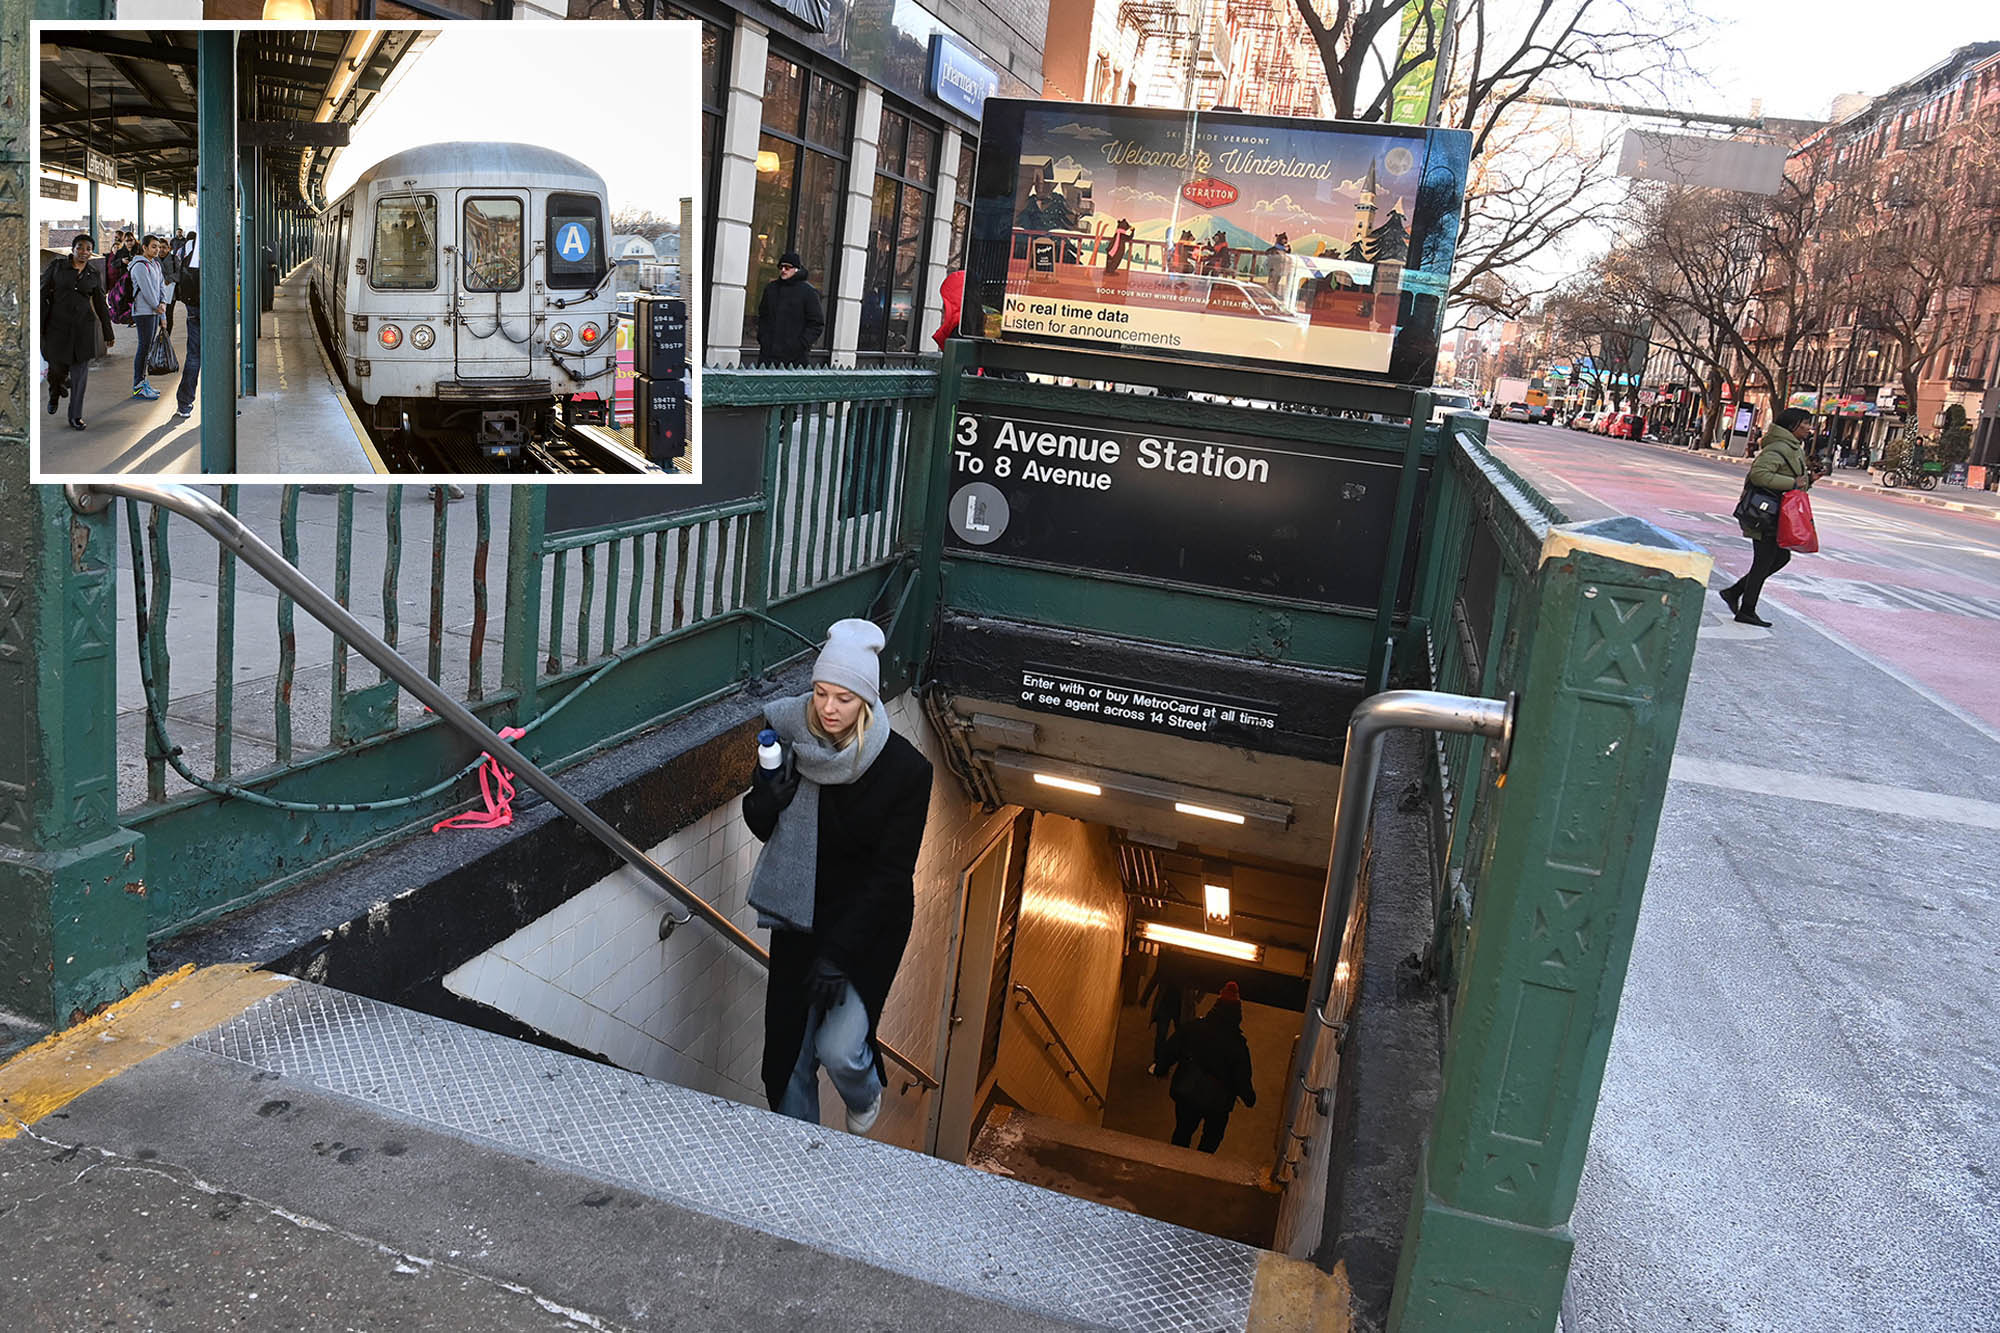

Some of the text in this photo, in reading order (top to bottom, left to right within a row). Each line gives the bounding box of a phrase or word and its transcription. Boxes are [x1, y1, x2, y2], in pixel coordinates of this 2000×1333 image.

[941, 56, 978, 104] pharmacy
[1197, 132, 1218, 141] RIDE
[1223, 135, 1270, 145] VERMONT
[1101, 139, 1332, 180] Welcome to Winterland
[1185, 186, 1234, 200] STRATTON
[562, 225, 585, 255] A
[1006, 298, 1130, 324] No real time data
[1096, 287, 1115, 295] BOOK
[1117, 289, 1134, 297] YOUR
[1136, 291, 1152, 299] NEXT
[1154, 293, 1177, 301] WINTER
[1004, 315, 1182, 347] Listen for announcements
[956, 416, 1270, 484] 3 Avenue Station
[953, 450, 1113, 491] To 8 Avenue
[965, 495, 990, 532] L
[1020, 690, 1208, 733] or see agent across 14 Street
[1022, 674, 1275, 730] Enter with or buy MetroCard at all times
